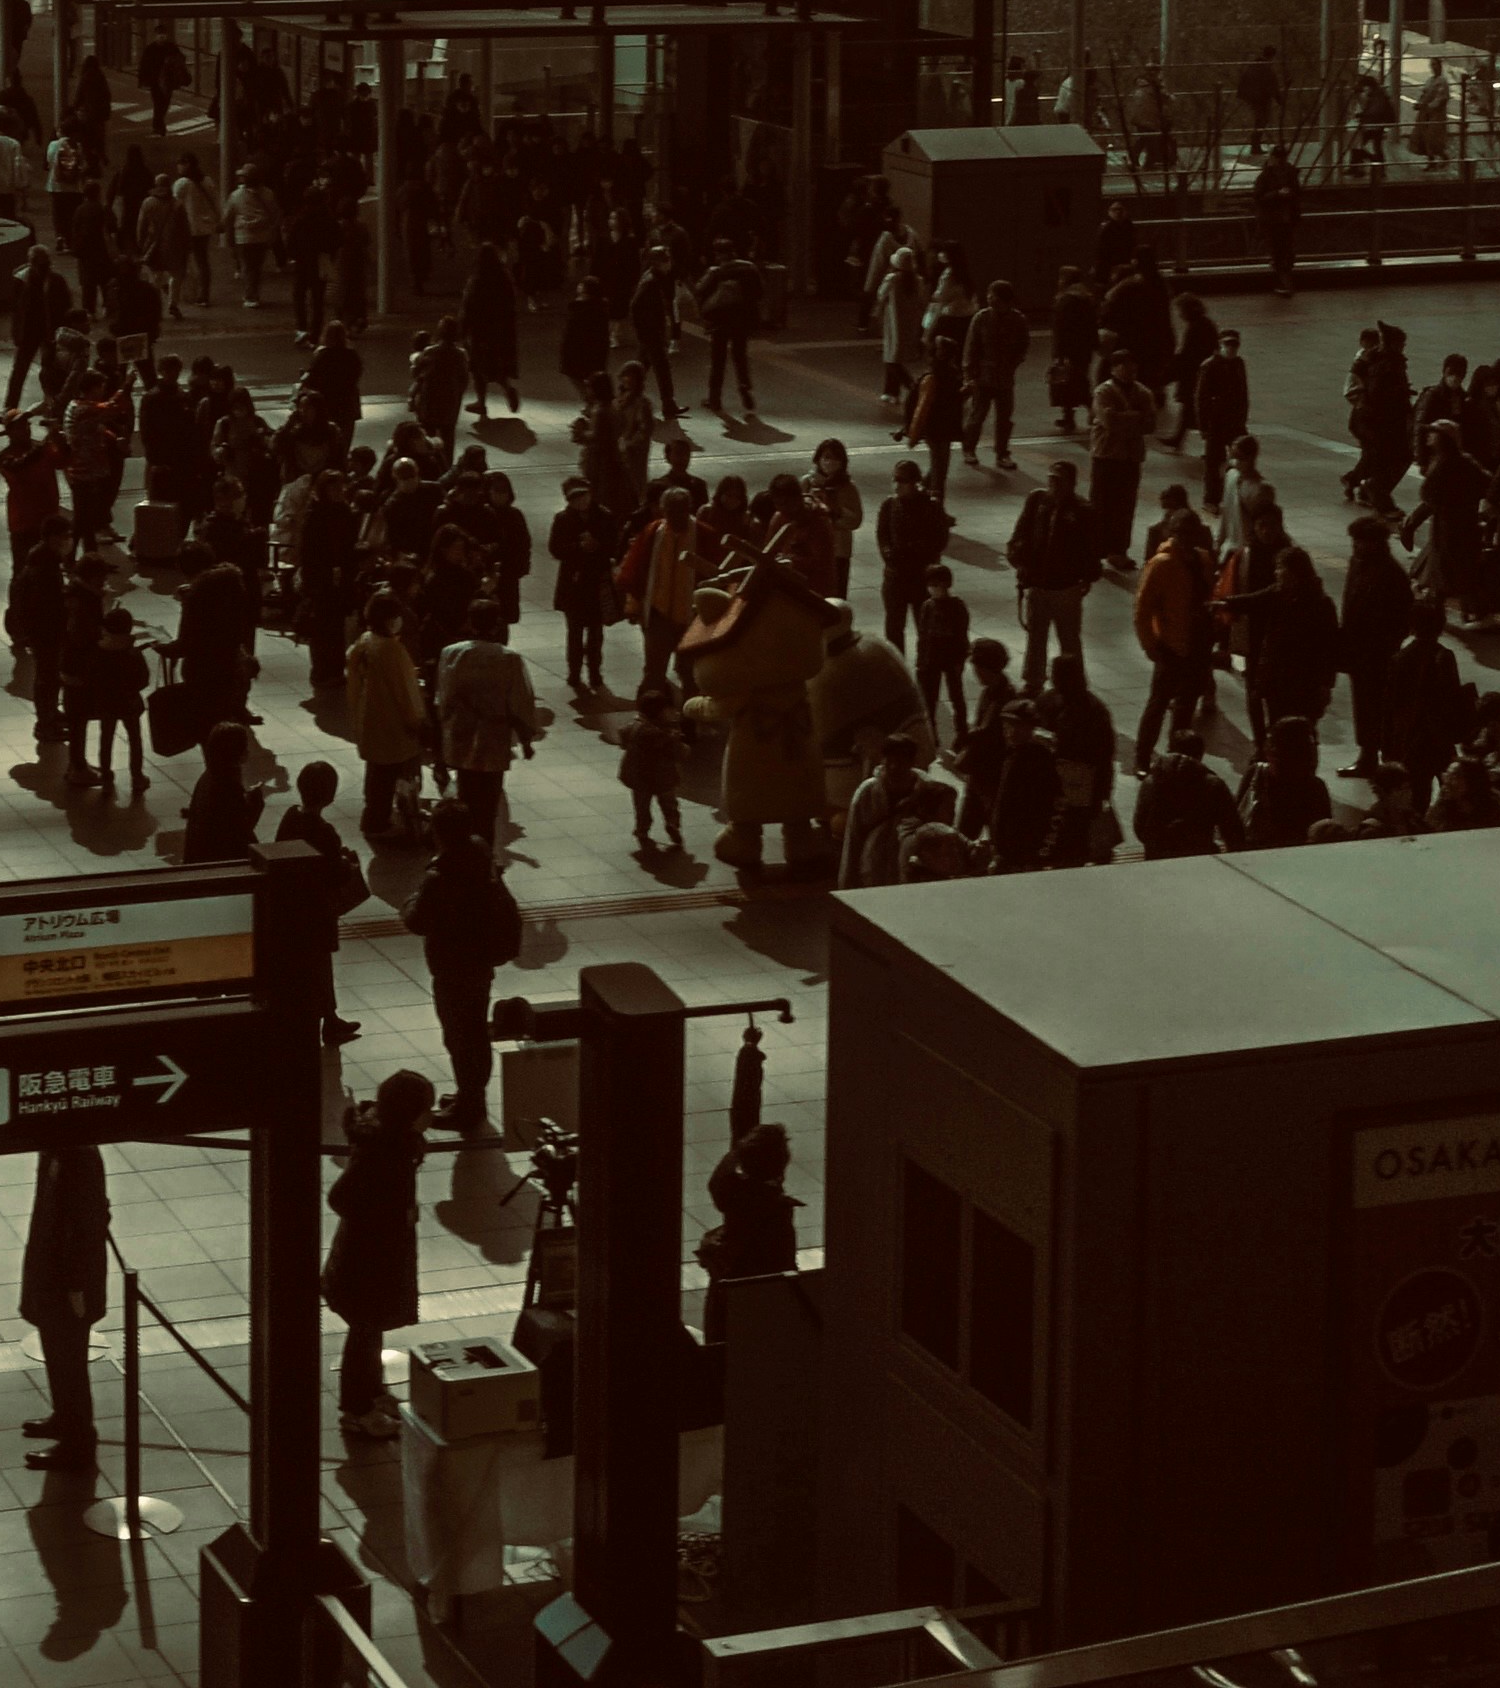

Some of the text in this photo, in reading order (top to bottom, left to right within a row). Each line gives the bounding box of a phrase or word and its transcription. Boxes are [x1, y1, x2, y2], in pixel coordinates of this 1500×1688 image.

[23, 909, 120, 930] アトリウム広場
[23, 955, 86, 974] 中央北口
[18, 1066, 117, 1098] 阪急電車
[71, 1094, 122, 1108] Railway
